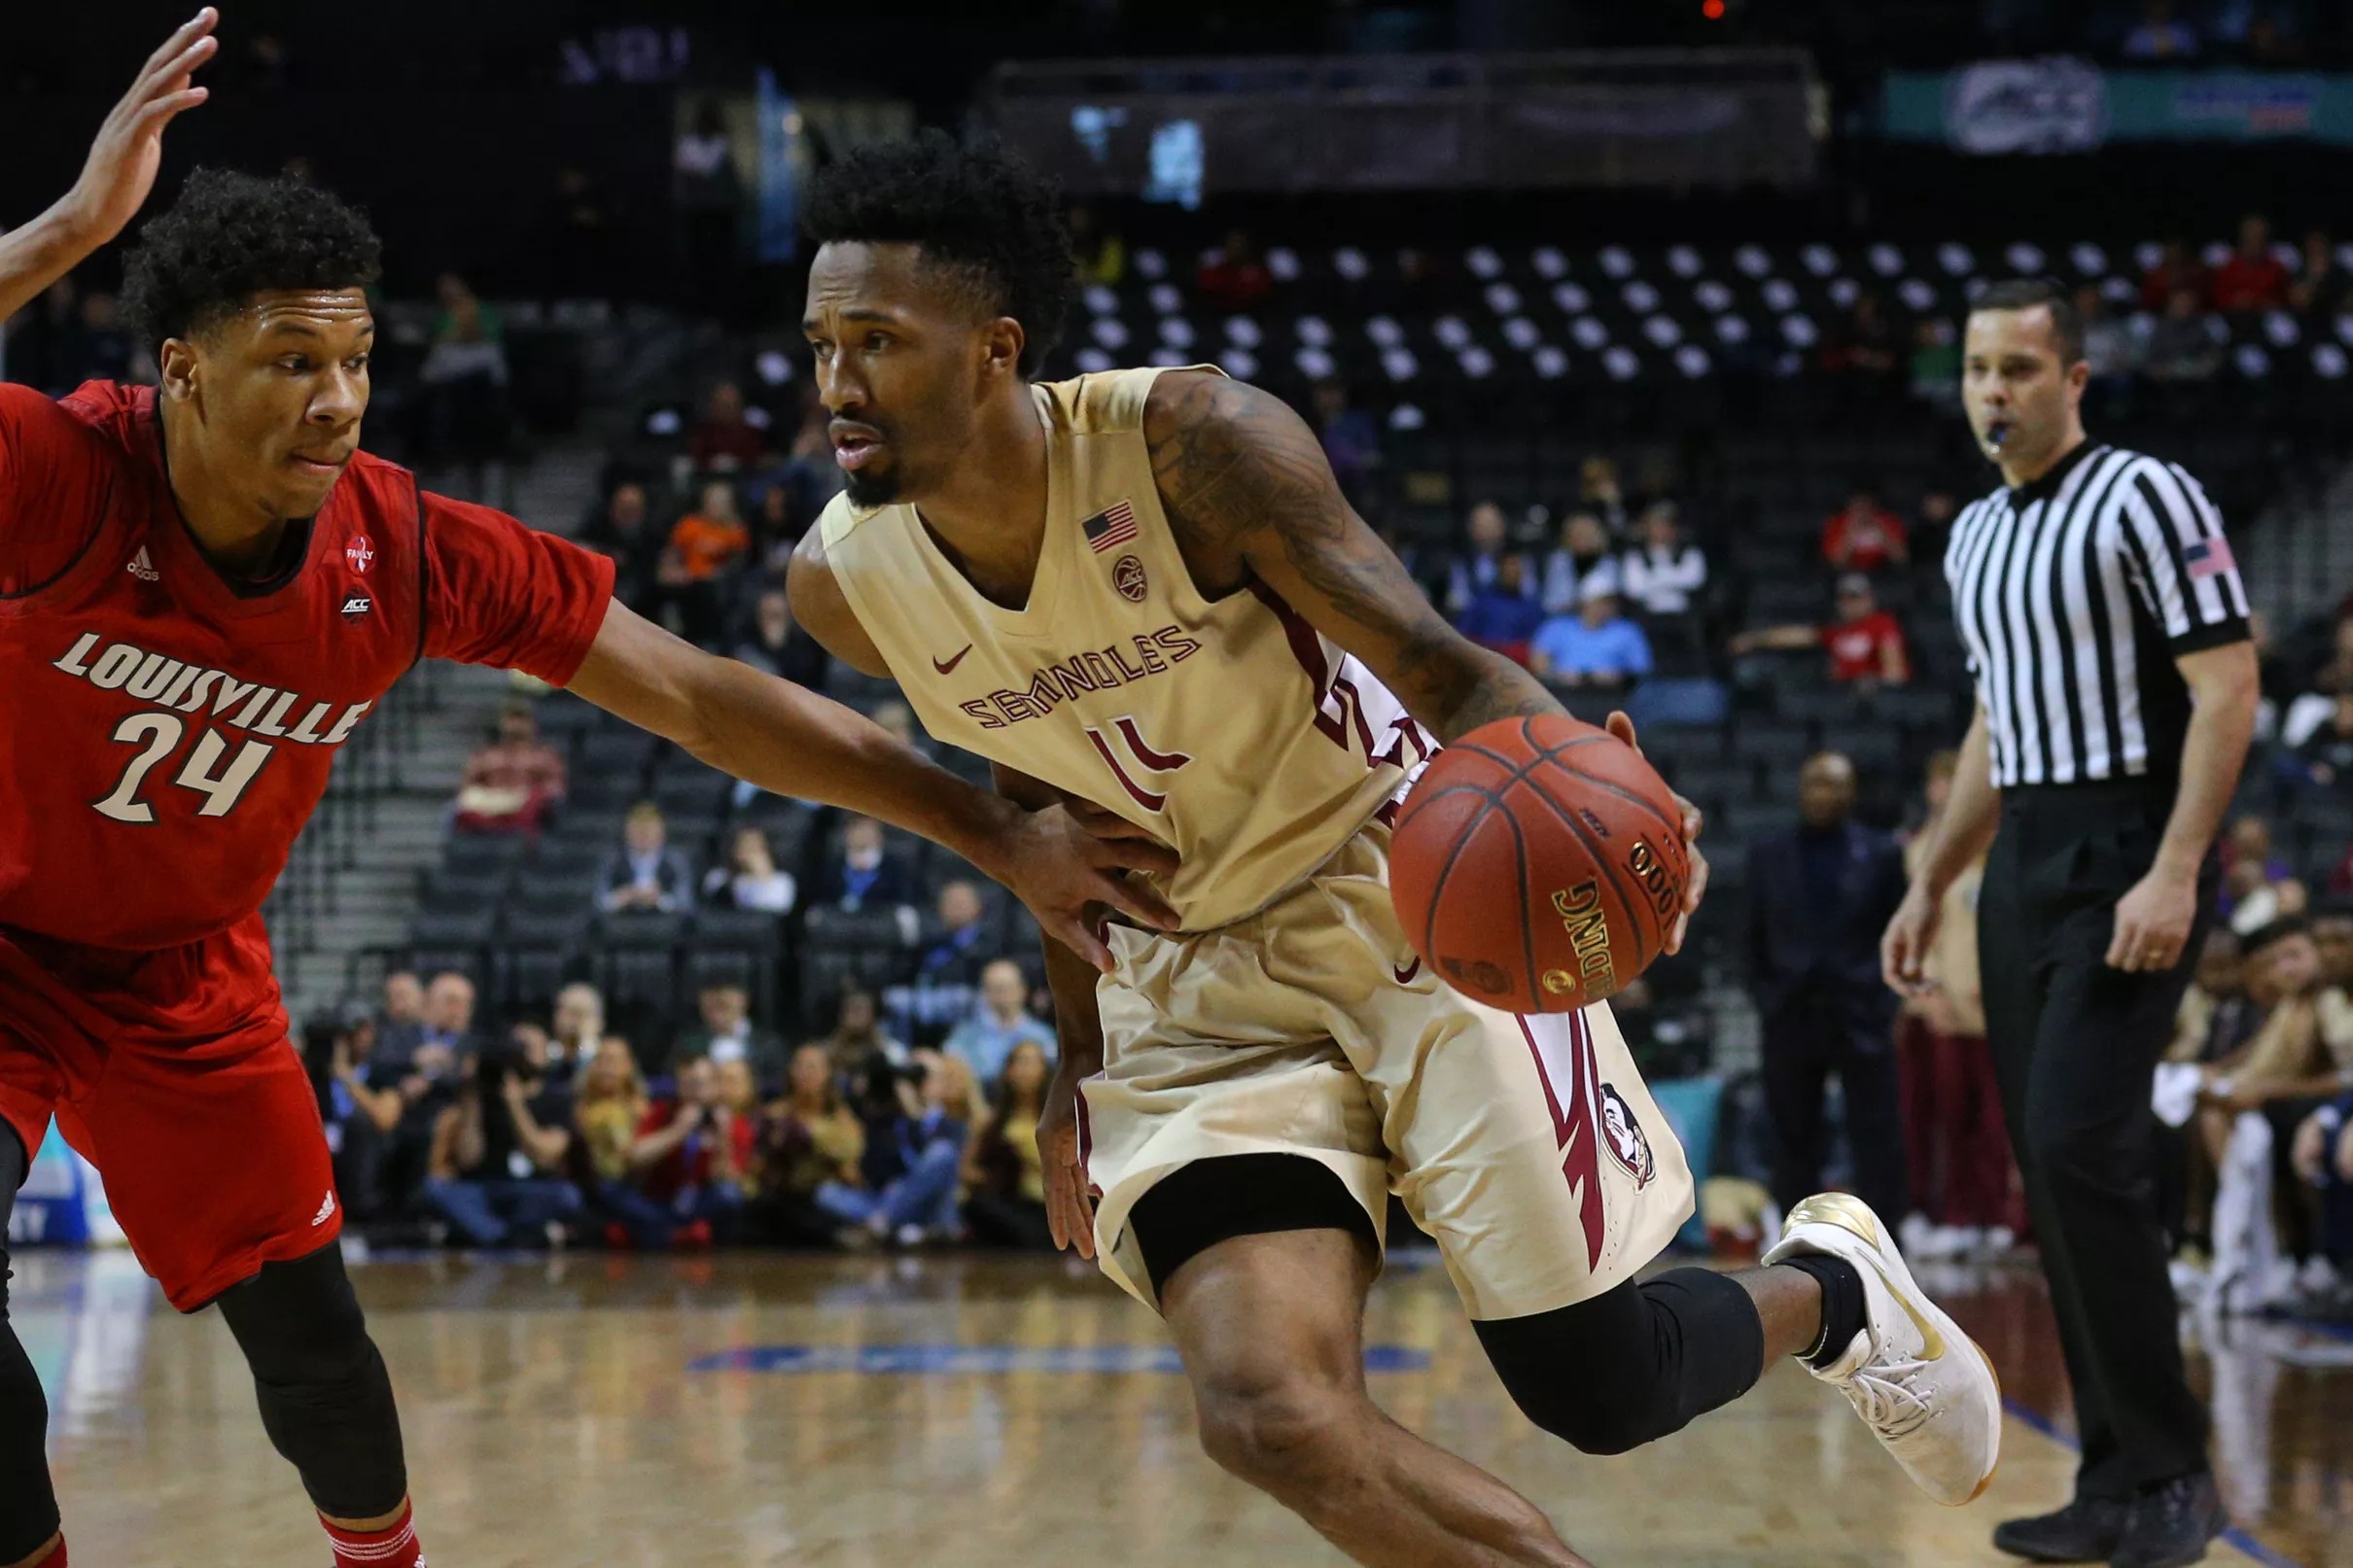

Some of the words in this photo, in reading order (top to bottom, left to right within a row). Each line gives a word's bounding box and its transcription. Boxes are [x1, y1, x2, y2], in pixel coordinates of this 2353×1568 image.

[343, 598, 370, 610] ACC
[52, 632, 373, 745] LOUISVILLE
[959, 625, 1203, 729] SEMNOLES
[91, 712, 274, 823] 24
[1083, 714, 1196, 815] 11
